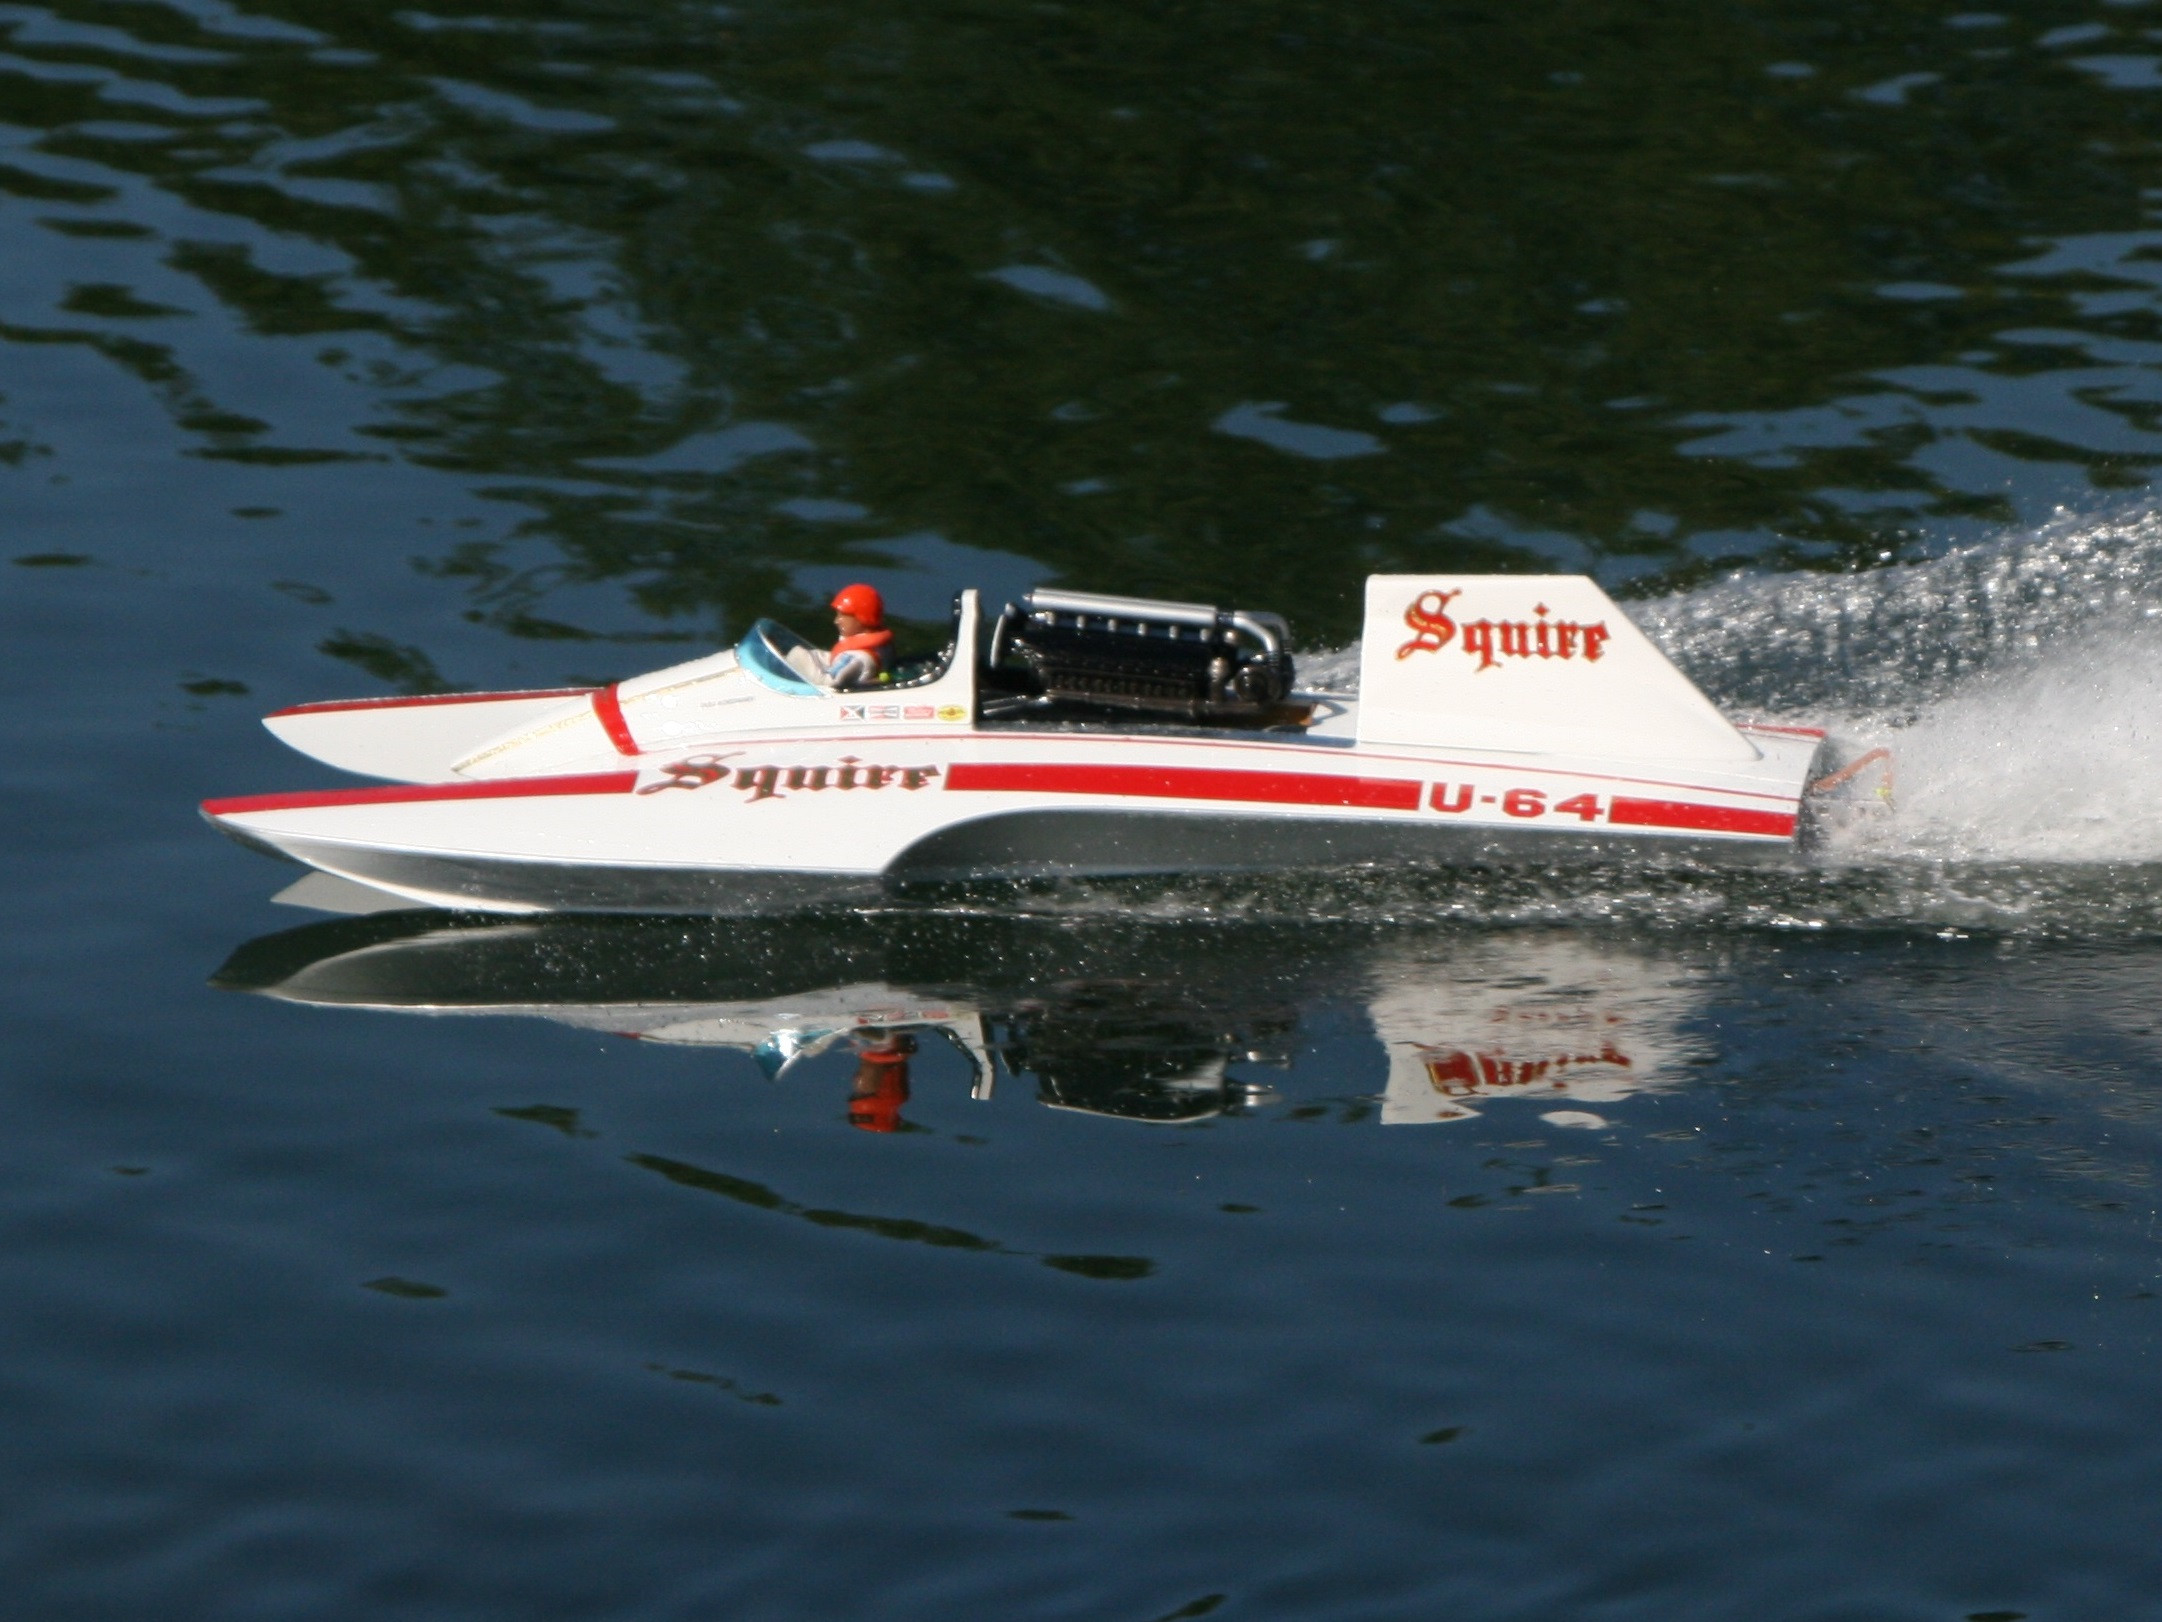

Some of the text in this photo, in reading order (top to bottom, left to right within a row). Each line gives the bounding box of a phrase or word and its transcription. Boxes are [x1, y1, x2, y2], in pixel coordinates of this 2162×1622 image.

[1396, 588, 1610, 672] Squire
[637, 752, 940, 803] Squire
[1429, 783, 1604, 821] U-64
